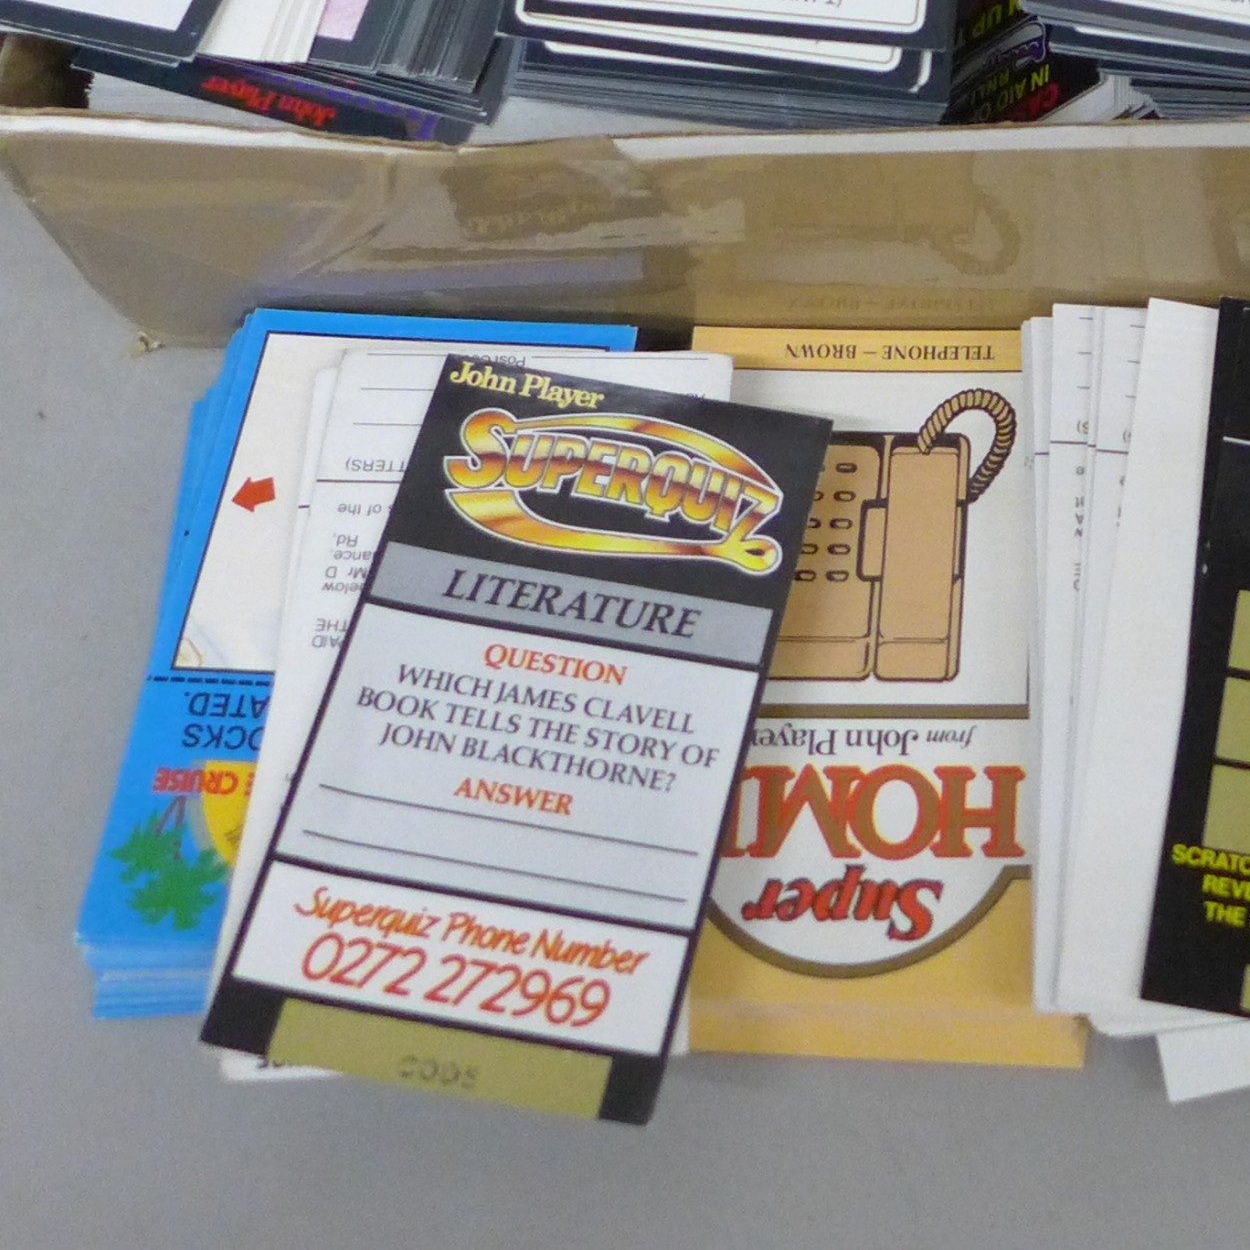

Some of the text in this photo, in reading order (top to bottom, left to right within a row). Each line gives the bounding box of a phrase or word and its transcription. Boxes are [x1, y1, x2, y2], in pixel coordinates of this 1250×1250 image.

[450, 361, 606, 409] John Player
[785, 343, 996, 362] TELEPHONE BROWN
[443, 408, 784, 575] SUPERQUIZ
[441, 570, 702, 639] LITERATURE
[484, 644, 627, 685] QUESTION
[357, 687, 720, 769] BOOK TELLS THE STORY OF
[399, 664, 694, 735] WHICH JAMES CLAVELL
[845, 724, 978, 757] from John
[453, 777, 573, 817] ANSWER
[730, 763, 1026, 860] HOM
[740, 864, 944, 941] Super
[1204, 900, 1247, 927] THE
[302, 932, 610, 1027] 0272 272969
